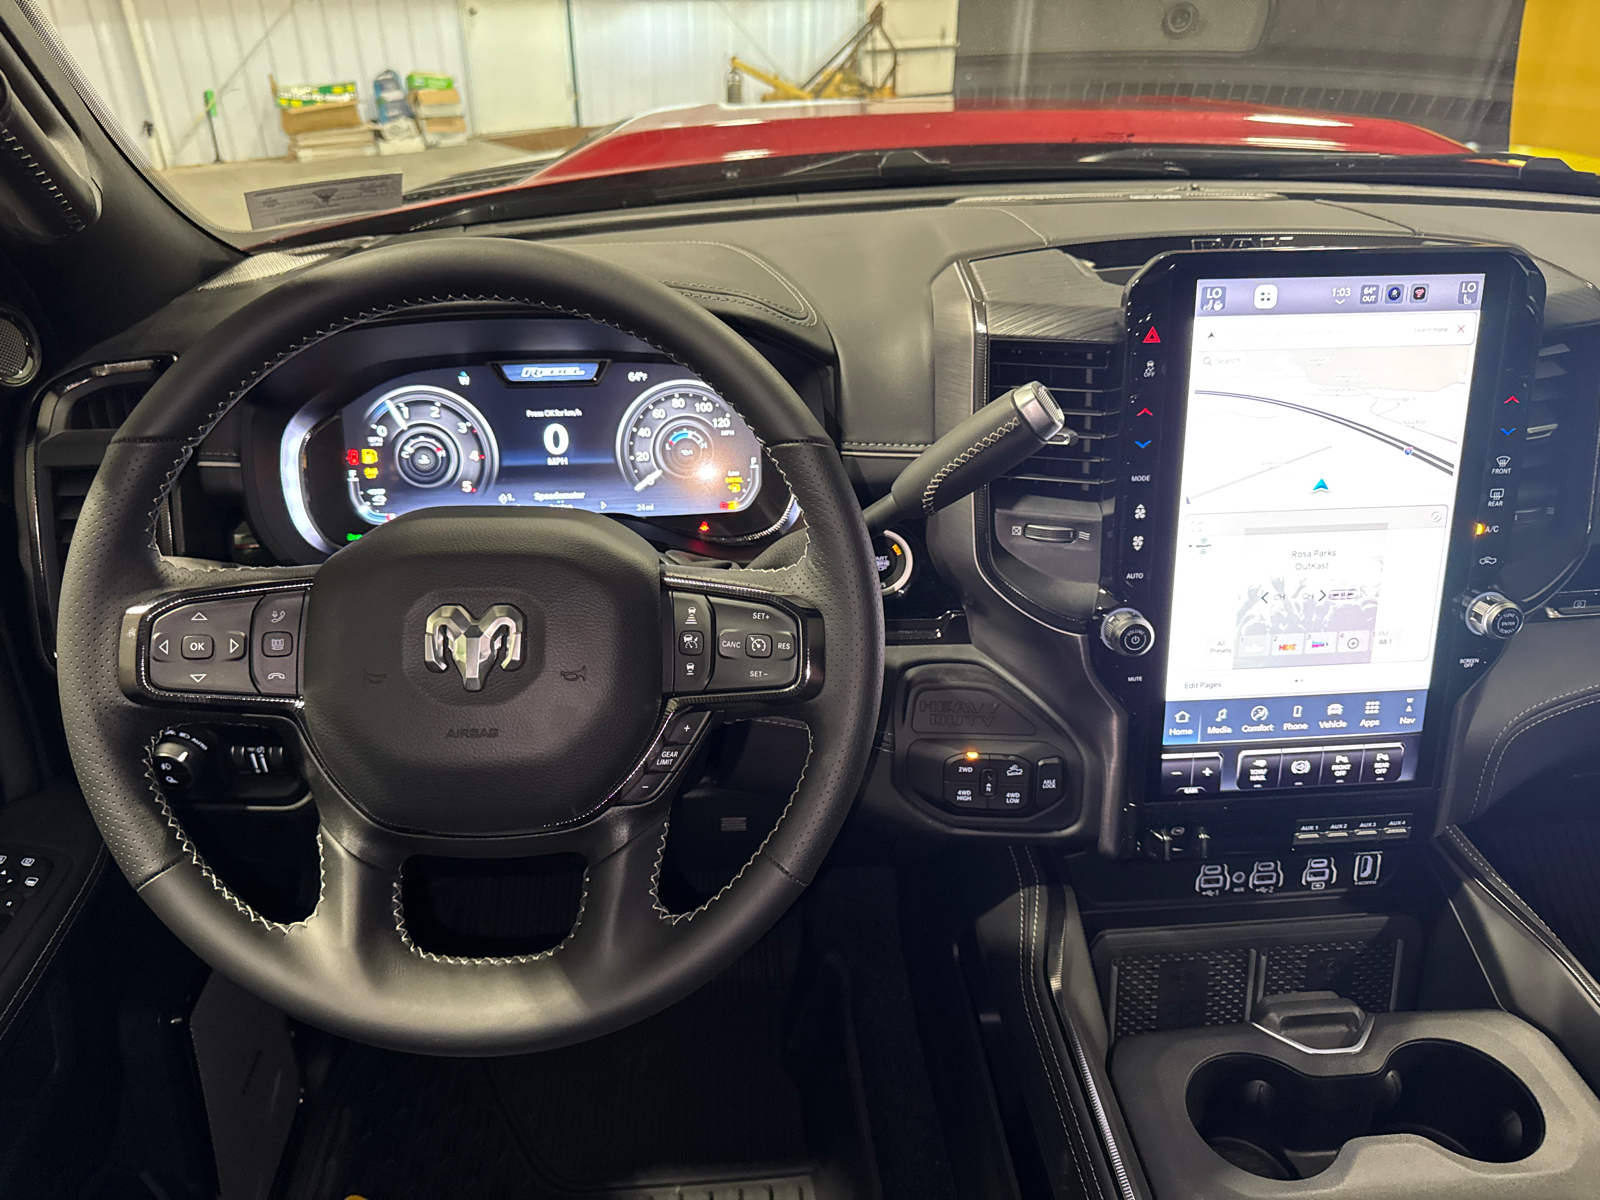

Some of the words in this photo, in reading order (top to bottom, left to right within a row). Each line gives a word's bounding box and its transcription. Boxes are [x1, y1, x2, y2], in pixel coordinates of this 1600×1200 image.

[1332, 287, 1351, 298] 1:03
[1364, 286, 1377, 294] 64°
[1461, 282, 1476, 293] LO
[1206, 288, 1222, 298] LO
[1414, 326, 1432, 334] Learn
[1216, 356, 1241, 365] Search
[458, 375, 470, 386] W
[628, 372, 648, 382] 64°F
[672, 398, 686, 408] 80
[695, 402, 713, 412] 100
[400, 406, 410, 420] 1
[430, 406, 440, 418] 2
[526, 410, 544, 418] Press
[544, 409, 554, 417] OK
[554, 408, 564, 417] for
[564, 408, 582, 417] km/h
[652, 408, 666, 419] 60
[458, 422, 468, 434] 3
[712, 418, 730, 428] 120
[376, 424, 388, 438] 0
[638, 428, 652, 438] 40
[544, 422, 570, 456] 0
[401, 450, 410, 458] C
[468, 450, 480, 462] 4
[636, 452, 650, 462] 20
[547, 457, 568, 466] MPH
[462, 480, 472, 492] 5
[533, 492, 586, 502] Speedometer
[719, 501, 728, 510] E
[1484, 525, 1499, 534] A/C
[1313, 549, 1336, 558] Parks
[1295, 562, 1330, 570] OutKast
[752, 612, 770, 620] SET+
[190, 642, 205, 651] OK
[722, 640, 741, 648] CANC
[1278, 644, 1297, 652] HEAT
[1200, 682, 1222, 690] Pages
[920, 700, 1000, 713] HEAVY
[930, 714, 996, 726] DUTY
[1319, 720, 1348, 729] Vehicle
[1360, 718, 1380, 728] Apps
[1399, 716, 1416, 724] Nav
[1169, 727, 1194, 736] Home
[1207, 726, 1232, 734] Media
[1242, 724, 1274, 732] Comfort
[1283, 722, 1308, 731] Phone
[446, 728, 498, 739] AIRBAG
[190, 737, 208, 751] AUTO
